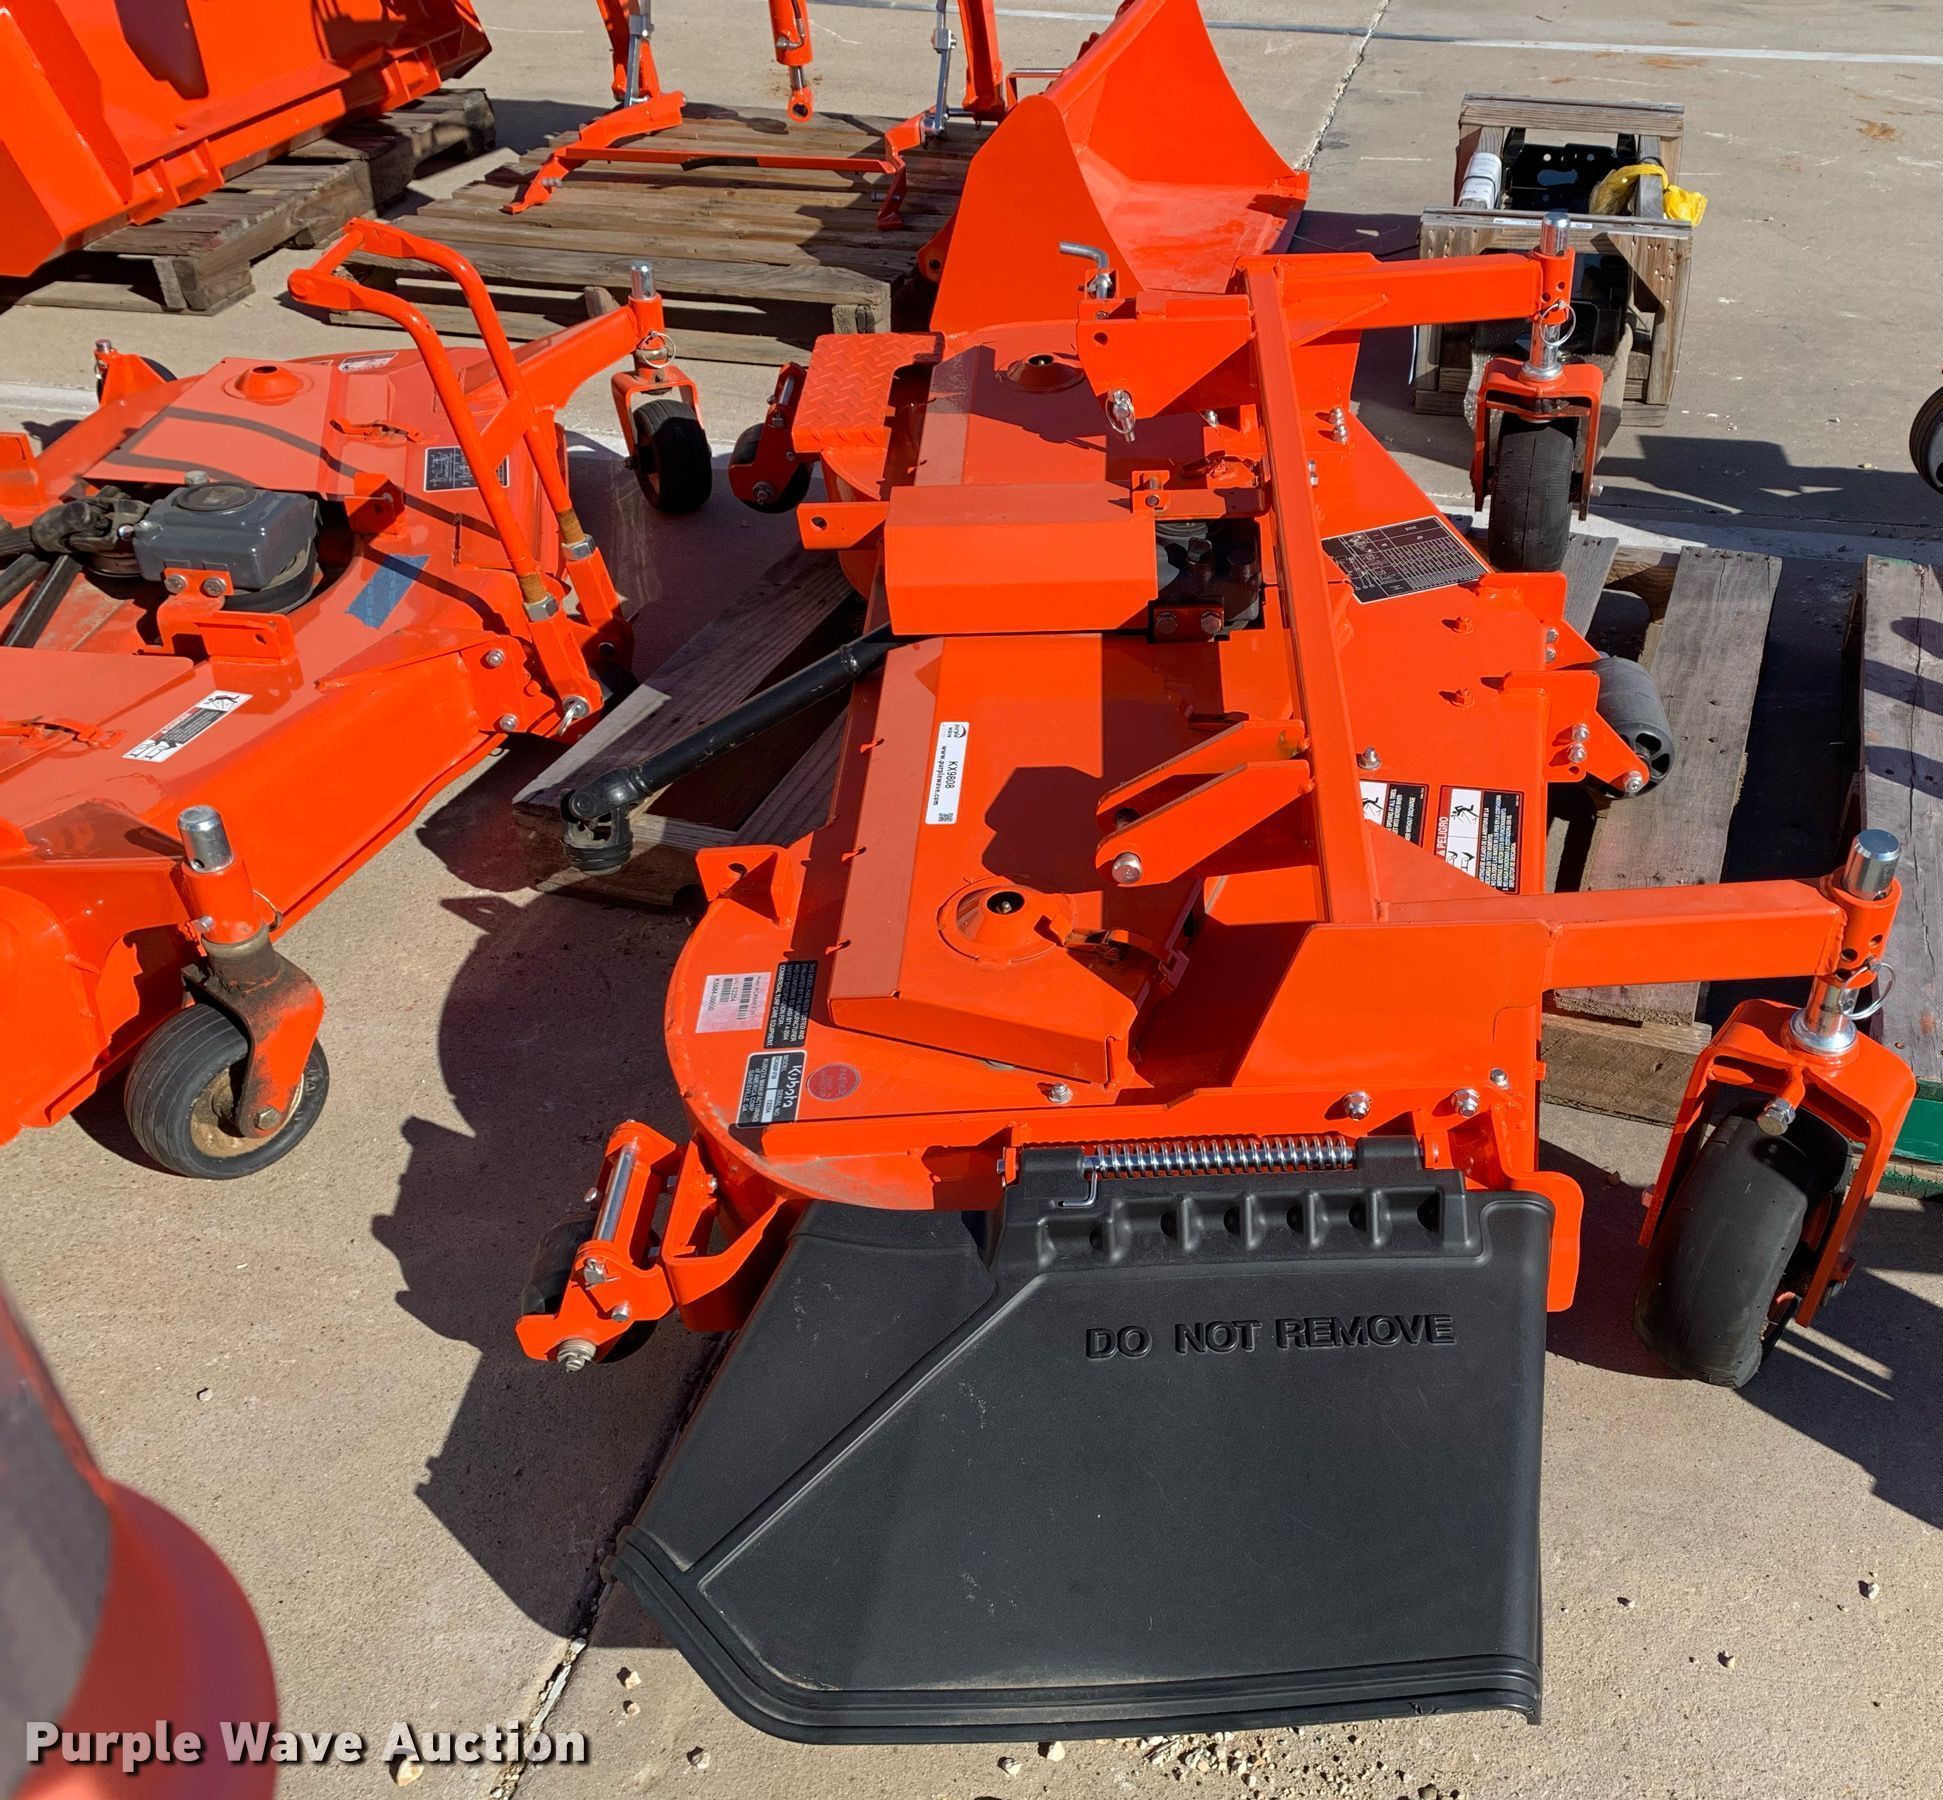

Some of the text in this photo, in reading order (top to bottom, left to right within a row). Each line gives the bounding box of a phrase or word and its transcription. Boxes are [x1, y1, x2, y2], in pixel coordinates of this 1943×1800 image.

[933, 746, 946, 805] www.purplewave.com
[944, 761, 958, 788] KX9808
[1437, 815, 1448, 848] PELIGRO
[775, 964, 786, 993] COMMERCIAL
[770, 1006, 778, 1018] CARE
[789, 1004, 801, 1041] MANUFACTURER
[799, 1012, 807, 1028] TESTED
[780, 1054, 789, 1072] MODEL
[750, 1073, 759, 1096] AMERICA
[752, 1058, 768, 1122] KUBOTA MANUFACTURING
[775, 1088, 783, 1106] SERIAL
[782, 1065, 802, 1107] Kubota
[741, 1103, 748, 1111] GA
[1085, 1313, 1457, 1361] DO NOT REMOVE
